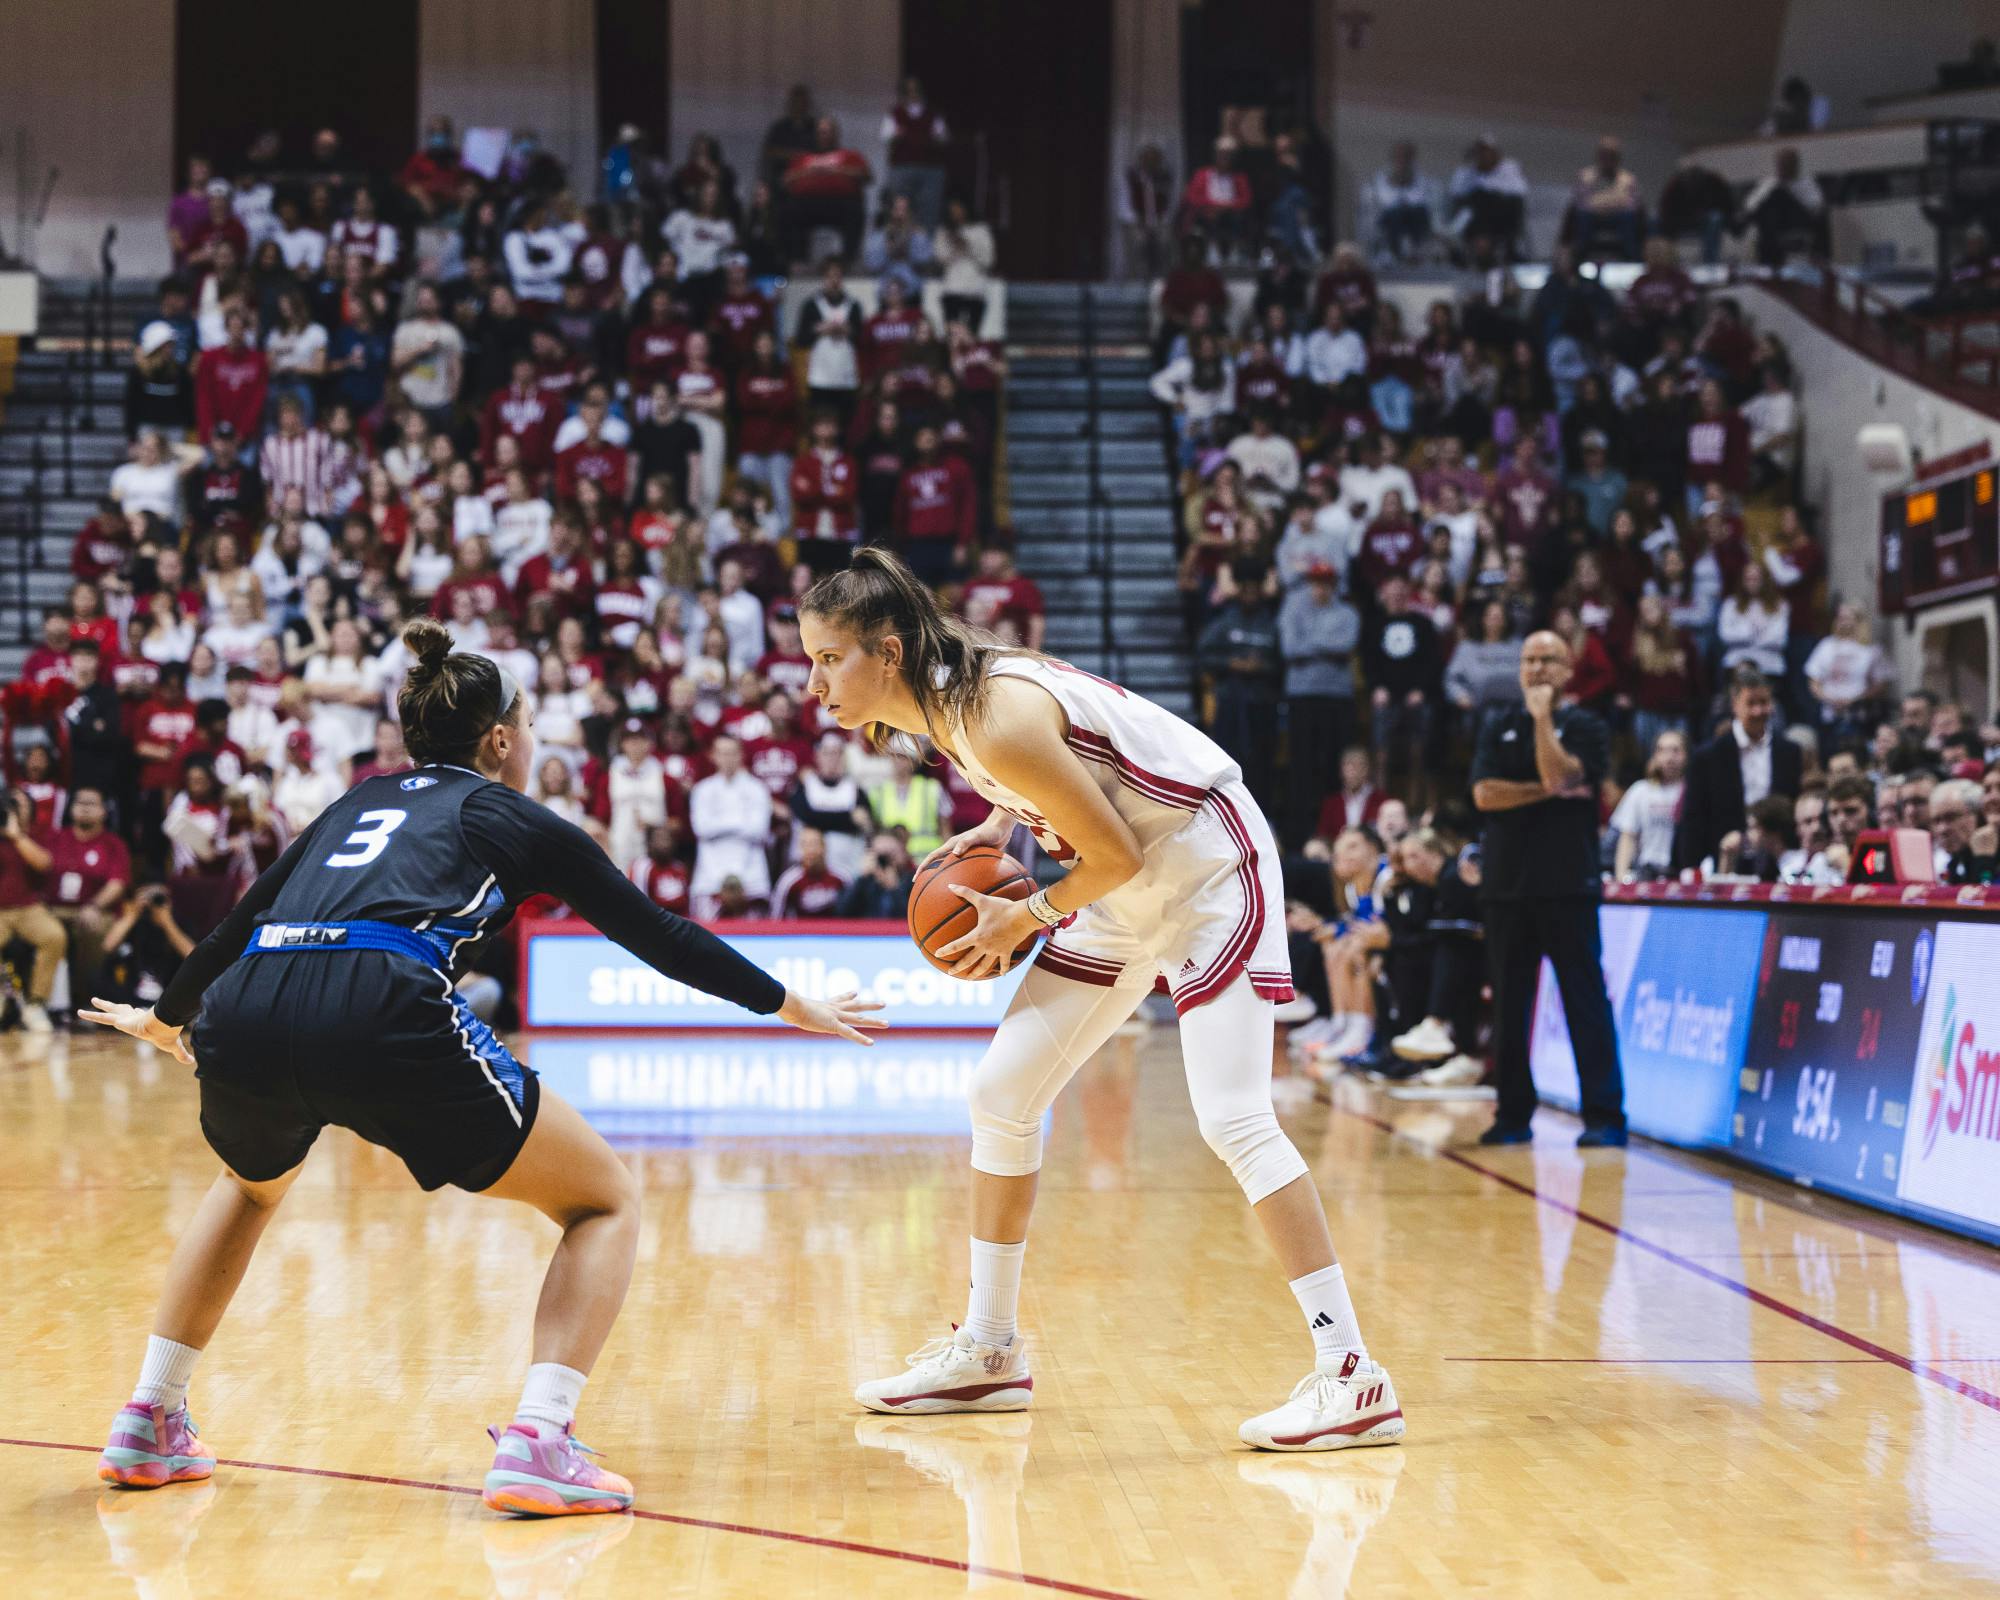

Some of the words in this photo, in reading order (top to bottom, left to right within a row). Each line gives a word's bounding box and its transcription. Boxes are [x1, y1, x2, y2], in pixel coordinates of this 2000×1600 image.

[326, 808, 407, 868] 3
[588, 956, 995, 1006] smille.com
[1179, 965, 1200, 979] adidas
